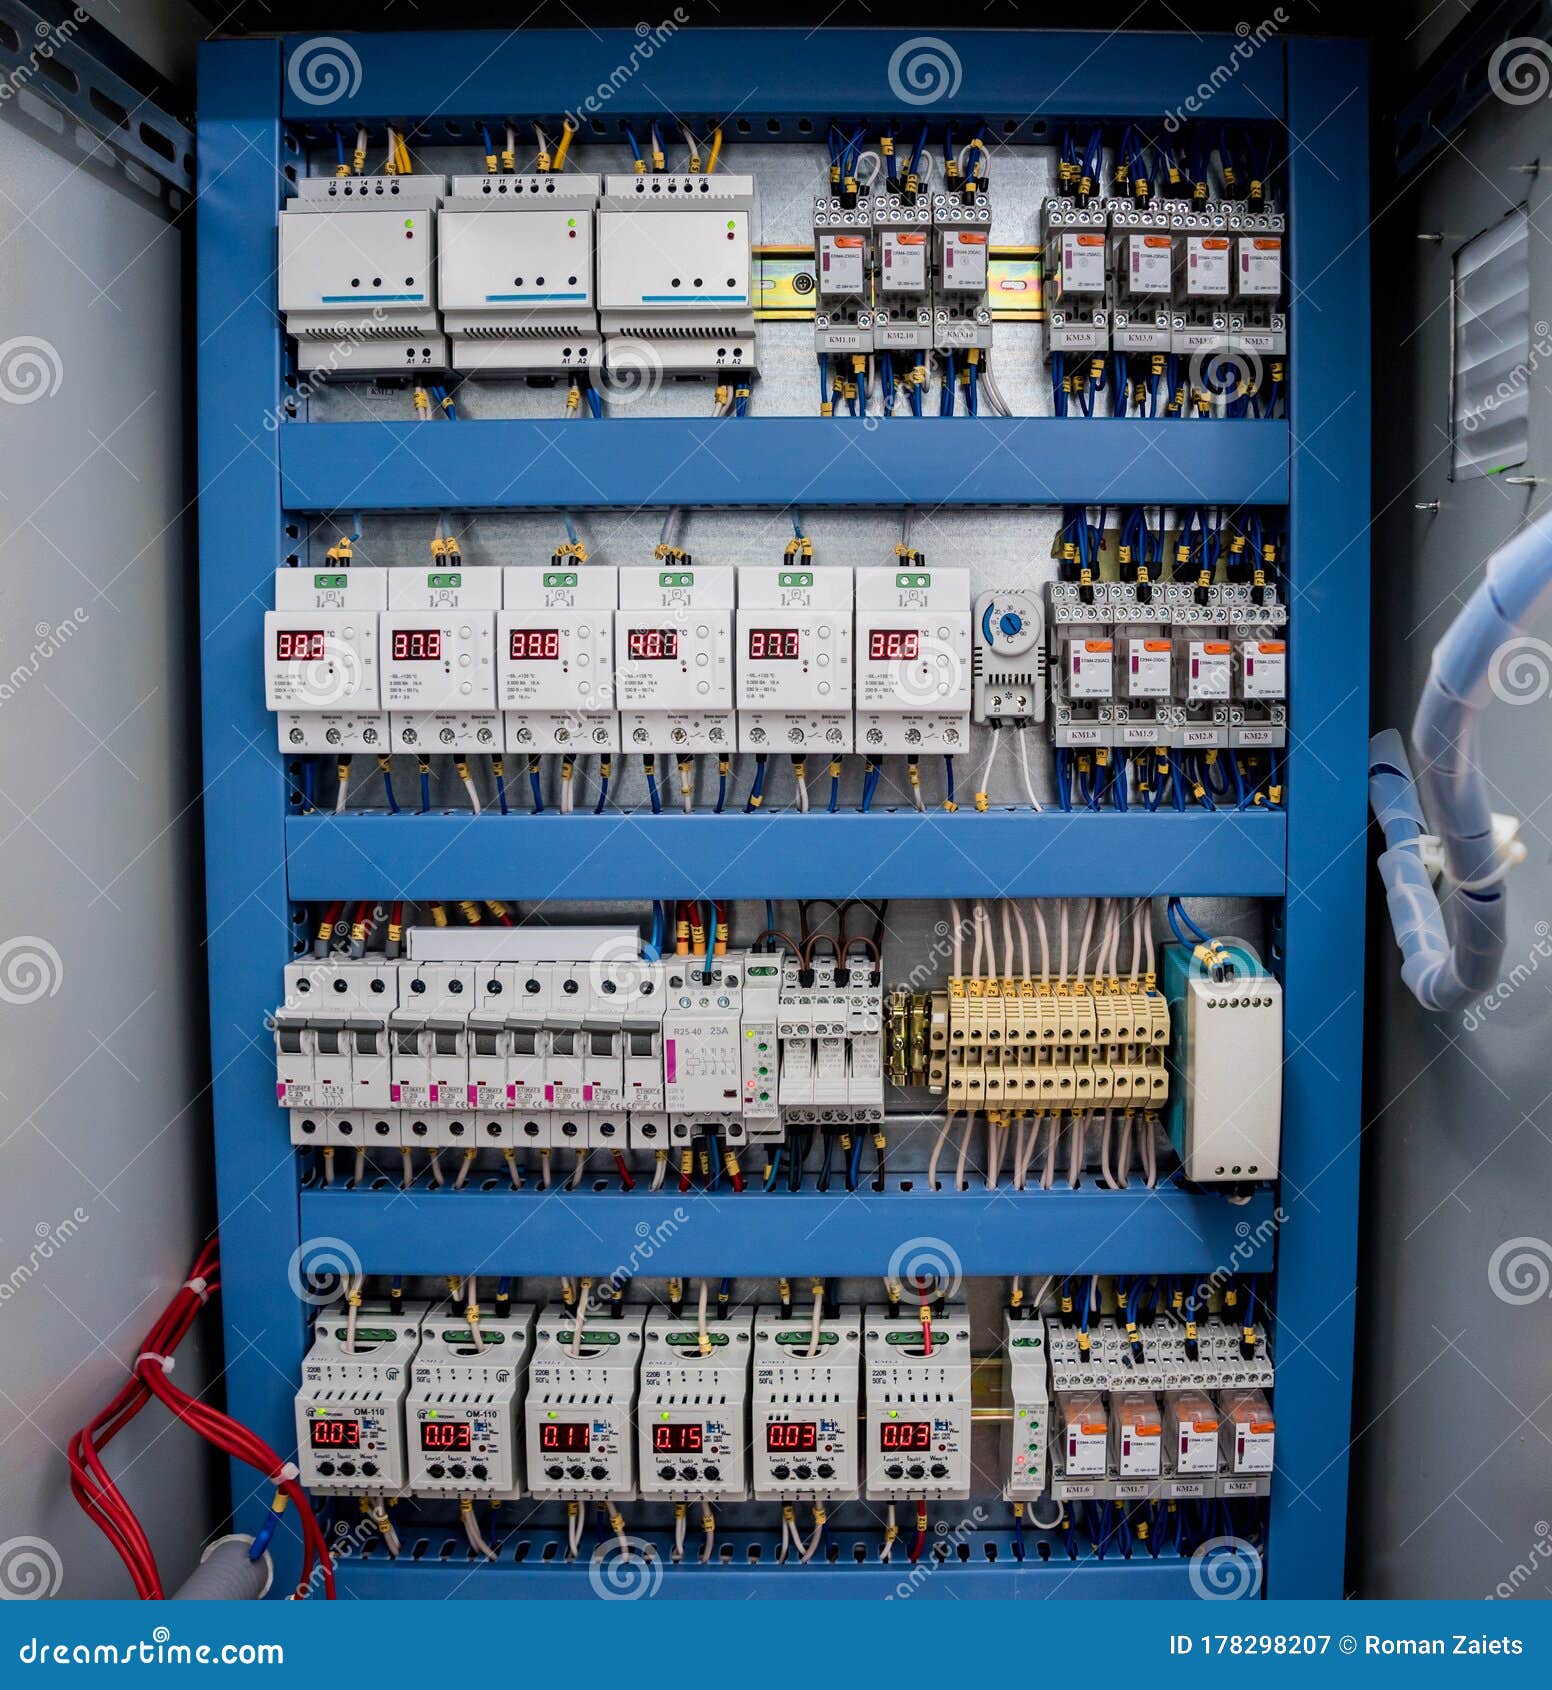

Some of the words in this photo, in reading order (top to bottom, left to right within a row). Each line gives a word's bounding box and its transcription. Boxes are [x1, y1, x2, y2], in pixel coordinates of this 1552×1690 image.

[887, 331, 914, 339] KM2.10
[1072, 731, 1096, 739] KM1.8
[711, 1027, 729, 1035] 25A
[315, 1422, 359, 1443] 0.03
[426, 1425, 470, 1446] 0.03
[544, 1426, 589, 1447] 0.11
[656, 1427, 701, 1448] 0.15
[770, 1426, 815, 1446] 0.03
[884, 1425, 929, 1446] 0.03
